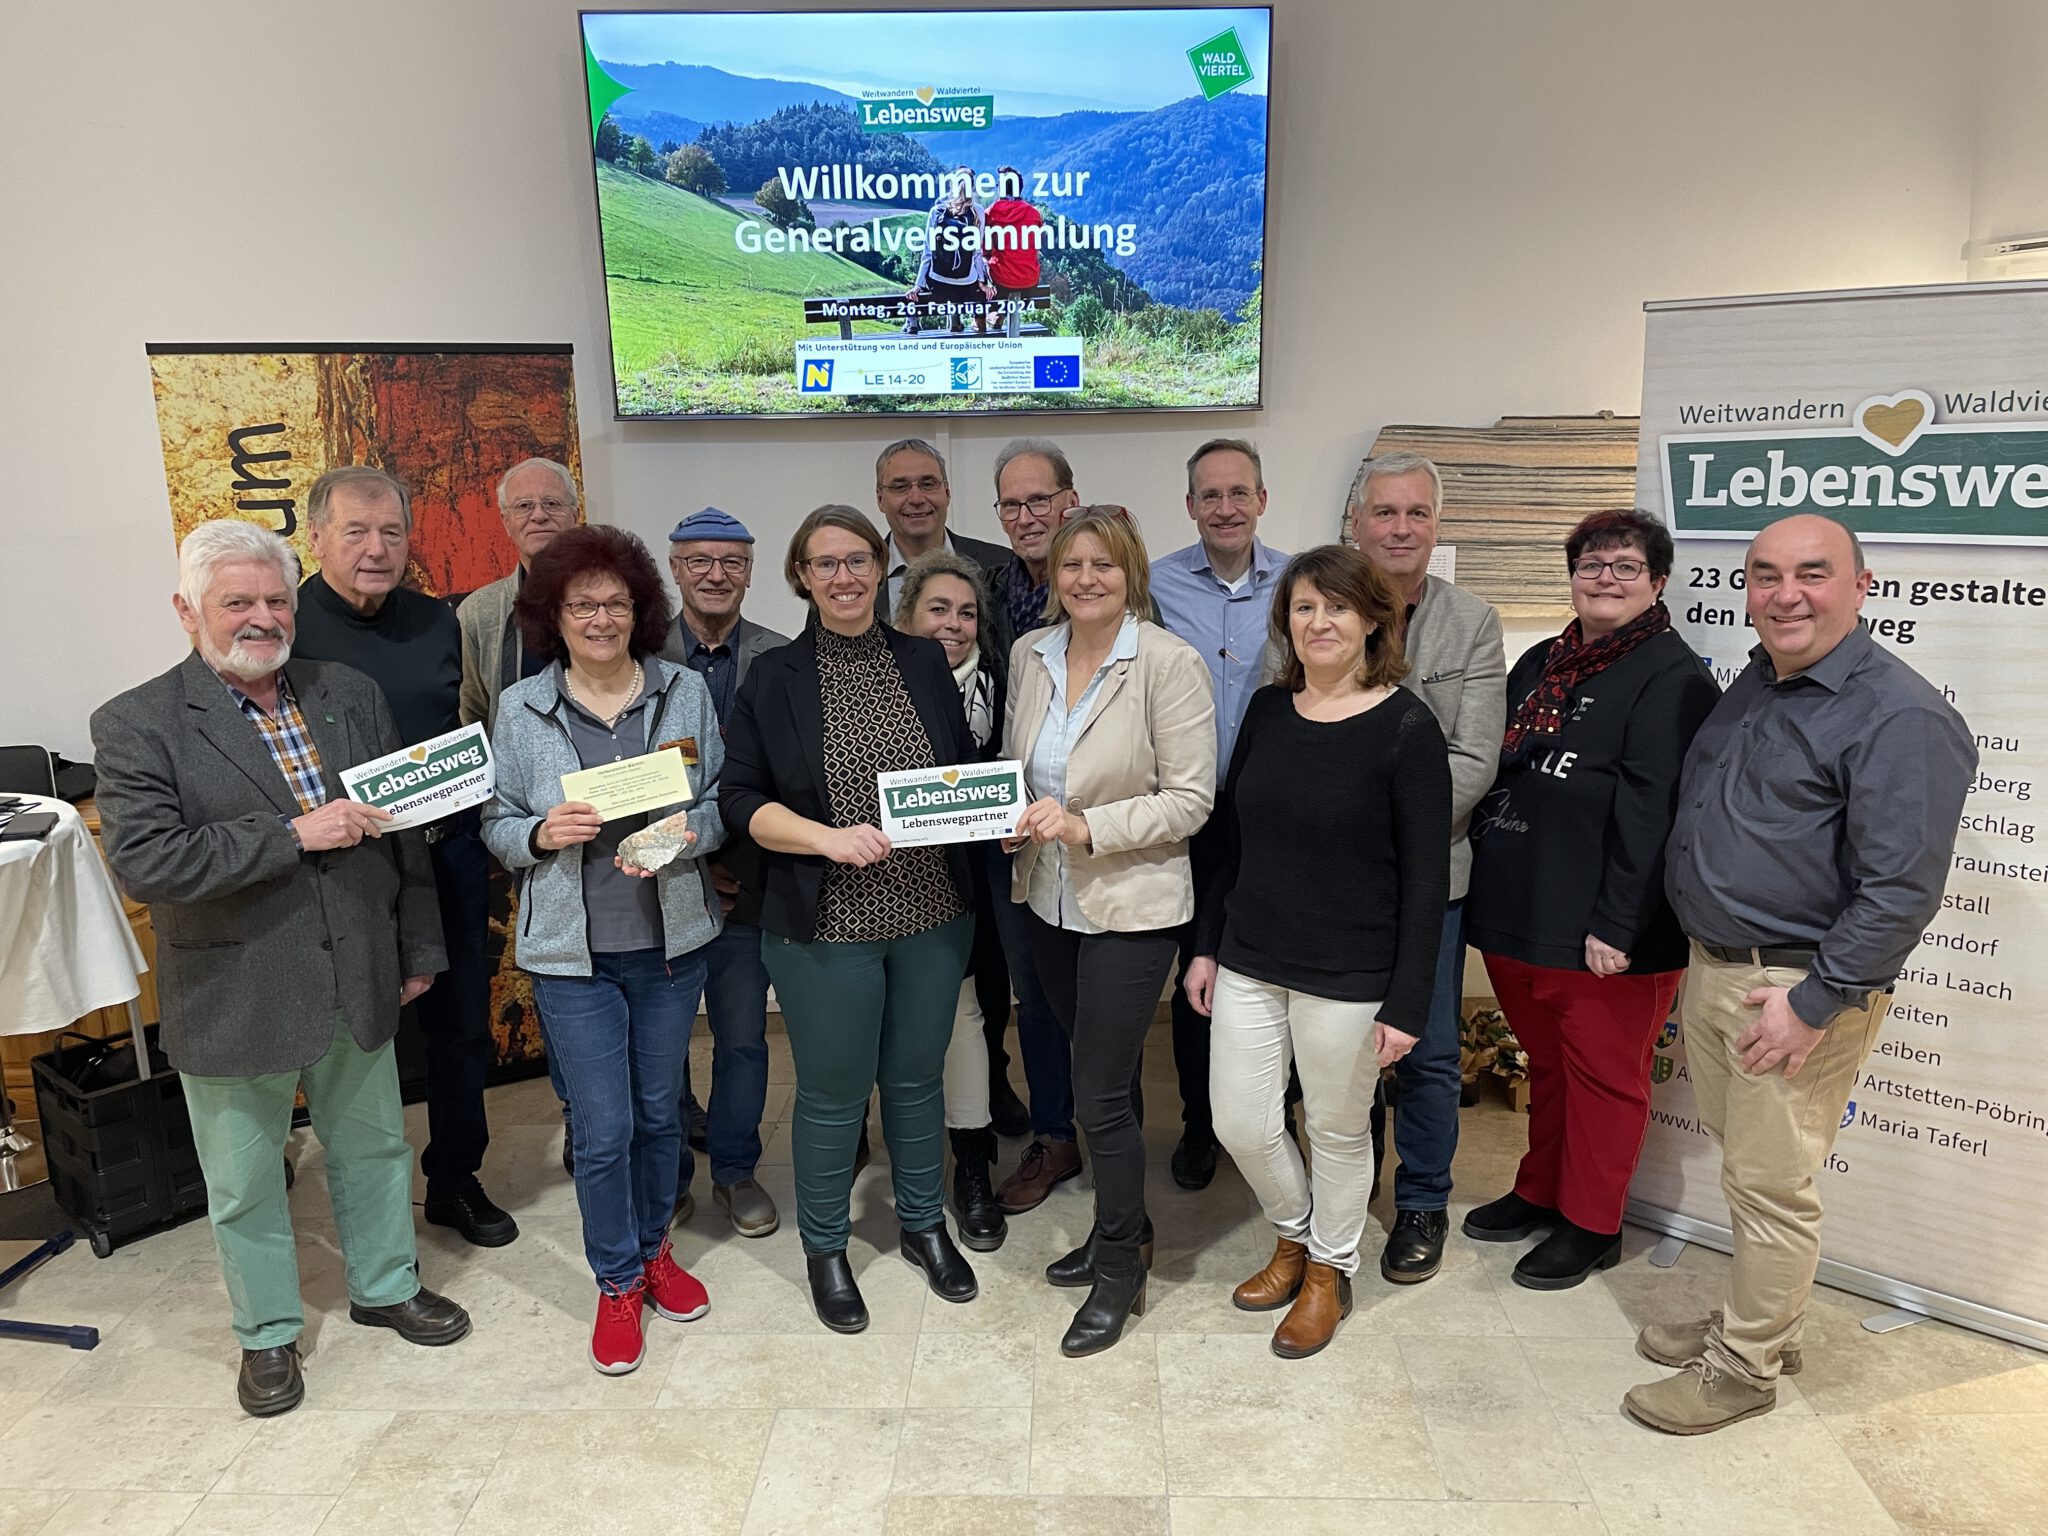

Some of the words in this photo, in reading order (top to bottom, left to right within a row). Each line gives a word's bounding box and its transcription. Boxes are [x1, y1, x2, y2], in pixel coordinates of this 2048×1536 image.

[1198, 64, 1245, 76] VIERTEL
[1202, 52, 1236, 64] WALD
[862, 89, 914, 98] Weitwandern
[936, 86, 981, 95] Waldviertel
[863, 103, 987, 128] Lebensweg
[777, 163, 1021, 200] Willkommen
[1032, 170, 1090, 198] zur
[734, 216, 1137, 257] Generalversammlung
[822, 302, 891, 319] Montag,
[896, 301, 922, 316] 26.
[928, 301, 991, 316] Februar
[997, 299, 1036, 314] 2024
[798, 343, 813, 352] Mit
[815, 343, 878, 353] Unterstützung
[898, 342, 919, 351] Land
[921, 342, 937, 351] und
[940, 341, 996, 351] Europäischer
[998, 341, 1023, 350] Union
[864, 374, 885, 386] LE
[888, 373, 926, 385] 14-20
[1679, 399, 1845, 425] Weitwandern
[1685, 450, 2048, 509] Lebenswe
[1688, 567, 1721, 589] 23
[1910, 579, 2047, 606] gestalte
[1686, 602, 1735, 626] den
[354, 754, 408, 781] Weitwandern
[427, 730, 469, 751] Waldviertel
[1975, 734, 2019, 752] nau
[360, 744, 484, 803] Lebensweg
[889, 774, 940, 786] Weitwandern
[961, 766, 1004, 778] Waldviertel
[1966, 771, 2033, 801] gberg
[387, 772, 486, 816] ebenswegpartner
[891, 782, 1012, 810] Lebensweg
[901, 811, 1009, 829] Lebenswegpartner
[1960, 814, 2036, 844] schlag
[1953, 851, 2048, 884] raunstei
[1942, 894, 1991, 915] stall
[1921, 932, 2000, 957] endorf
[1897, 967, 1939, 986] aria
[1945, 972, 2013, 1001] Laach
[1886, 1001, 1949, 1028] eiten
[1863, 1074, 2048, 1137] Artstetten-Pöbrin
[1860, 1111, 1920, 1140] Maria
[1926, 1126, 1988, 1158] Taferl
